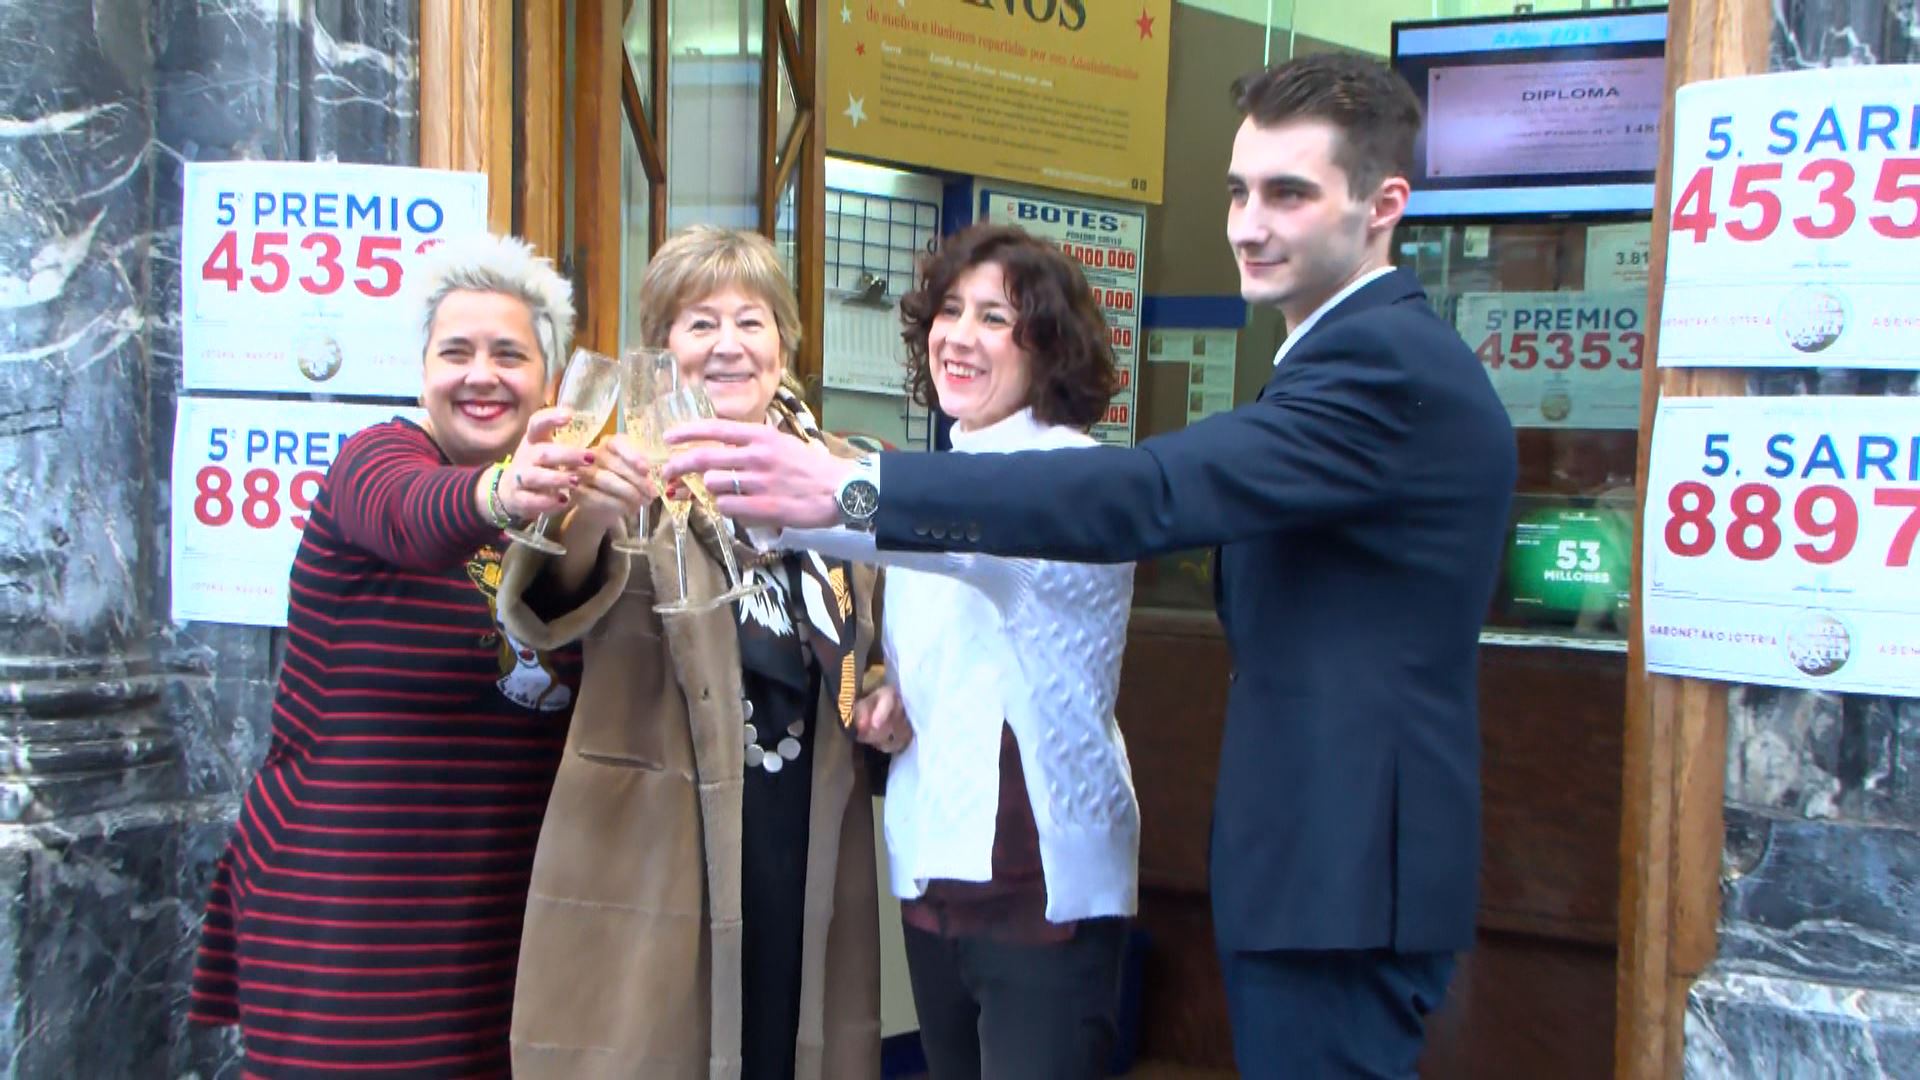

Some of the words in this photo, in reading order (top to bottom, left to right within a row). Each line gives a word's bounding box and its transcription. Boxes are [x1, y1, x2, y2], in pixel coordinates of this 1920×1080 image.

[1522, 86, 1620, 102] DIPLOMA
[1705, 115, 1744, 161] 5.
[254, 191, 444, 233] PREMIO
[1018, 201, 1119, 232] BOTES
[1671, 157, 1920, 243] 4535
[202, 230, 445, 297] 4535
[1513, 307, 1638, 330] PREMIO
[1474, 331, 1645, 371] 45353
[246, 428, 350, 467] PRE
[1702, 432, 1742, 478] 5.
[1664, 481, 1920, 567] 8897
[1556, 539, 1601, 572] 53
[1543, 569, 1611, 584] MILLONES
